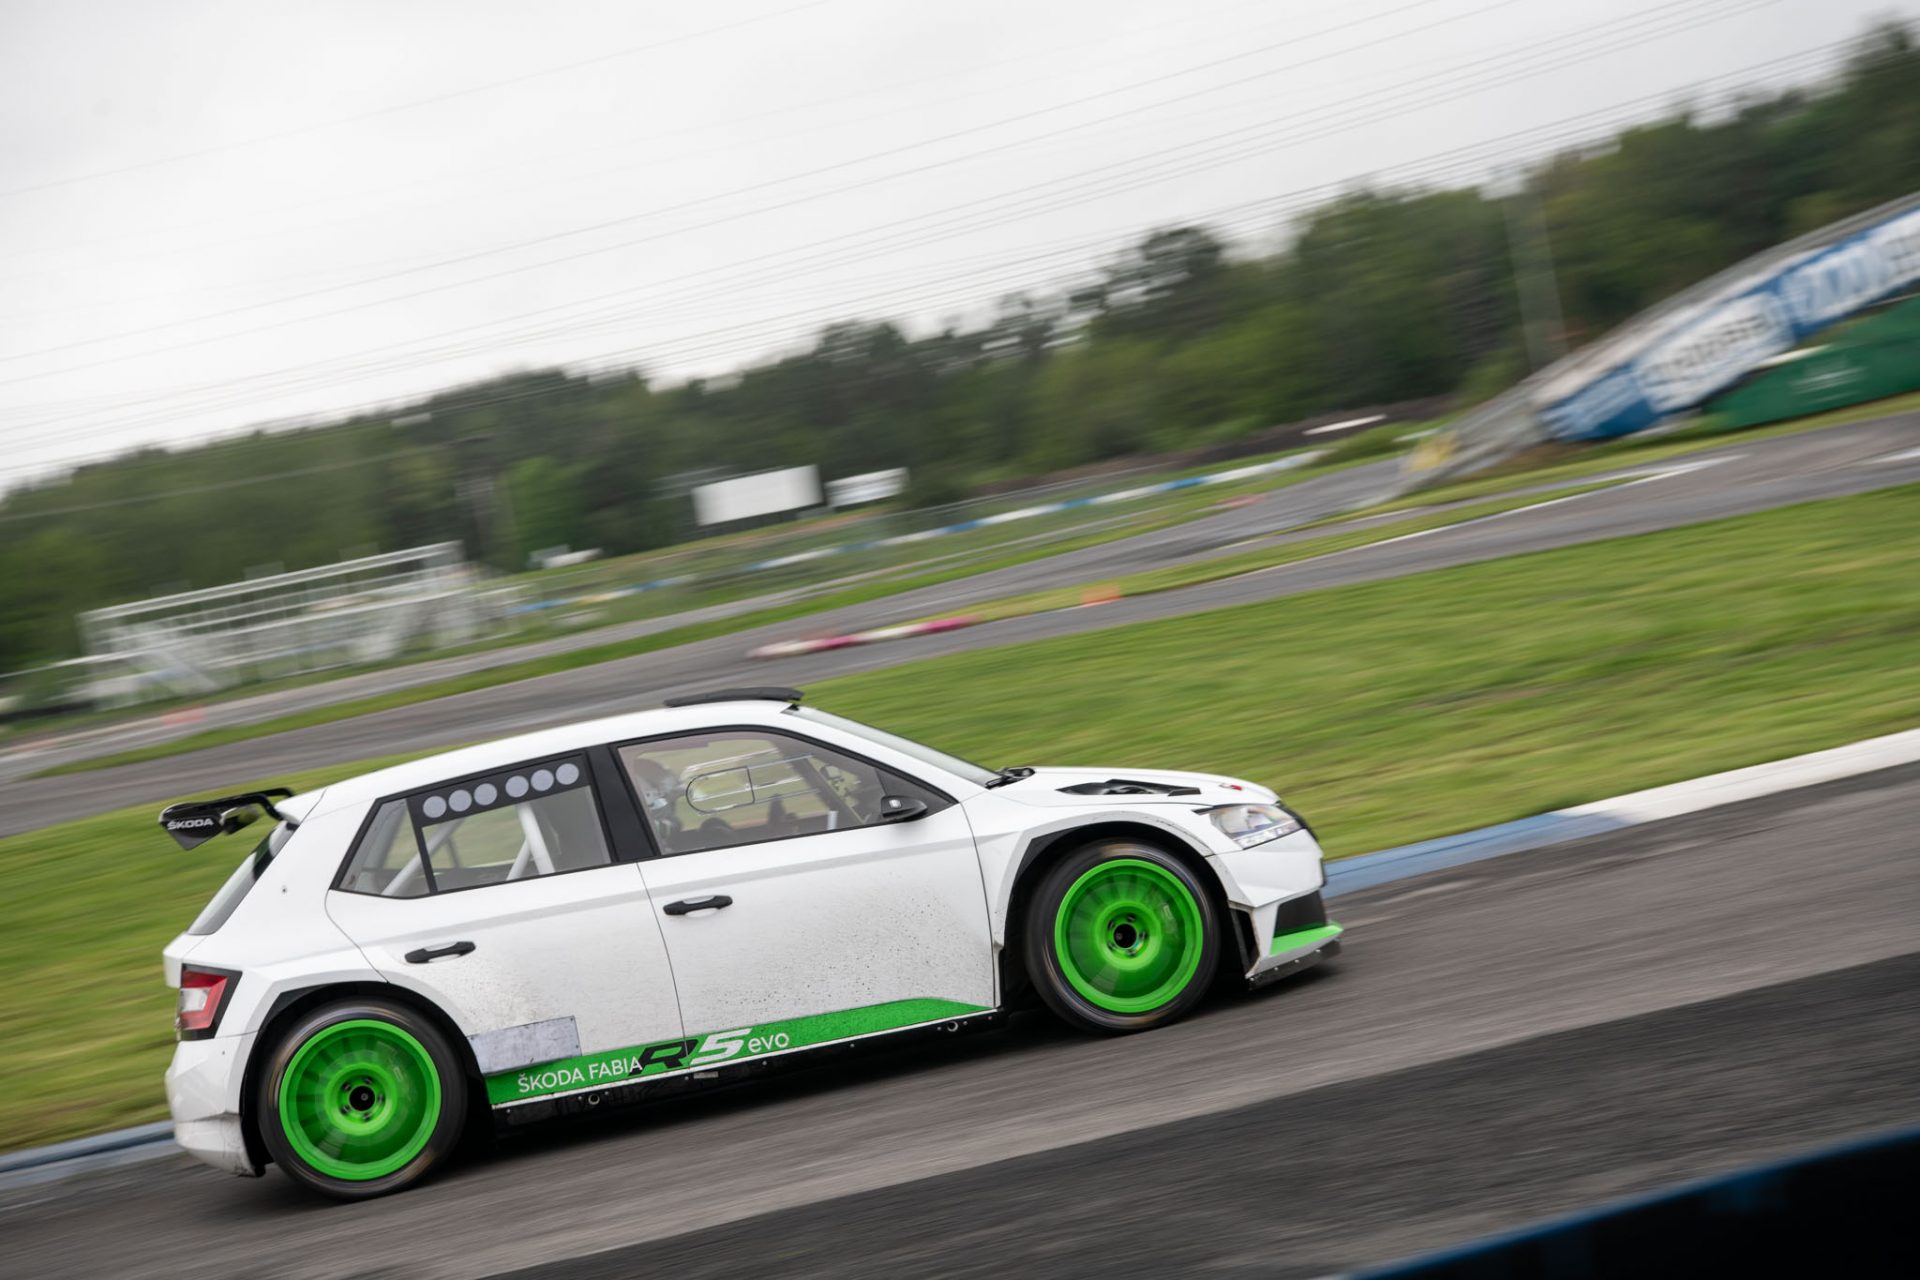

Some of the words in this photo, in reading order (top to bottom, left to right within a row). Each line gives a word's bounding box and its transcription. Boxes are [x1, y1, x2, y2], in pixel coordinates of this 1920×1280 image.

[518, 1067, 585, 1093] ŠKODA
[588, 1055, 643, 1080] FABIA
[628, 1027, 752, 1076] R5
[748, 1032, 789, 1053] evo
